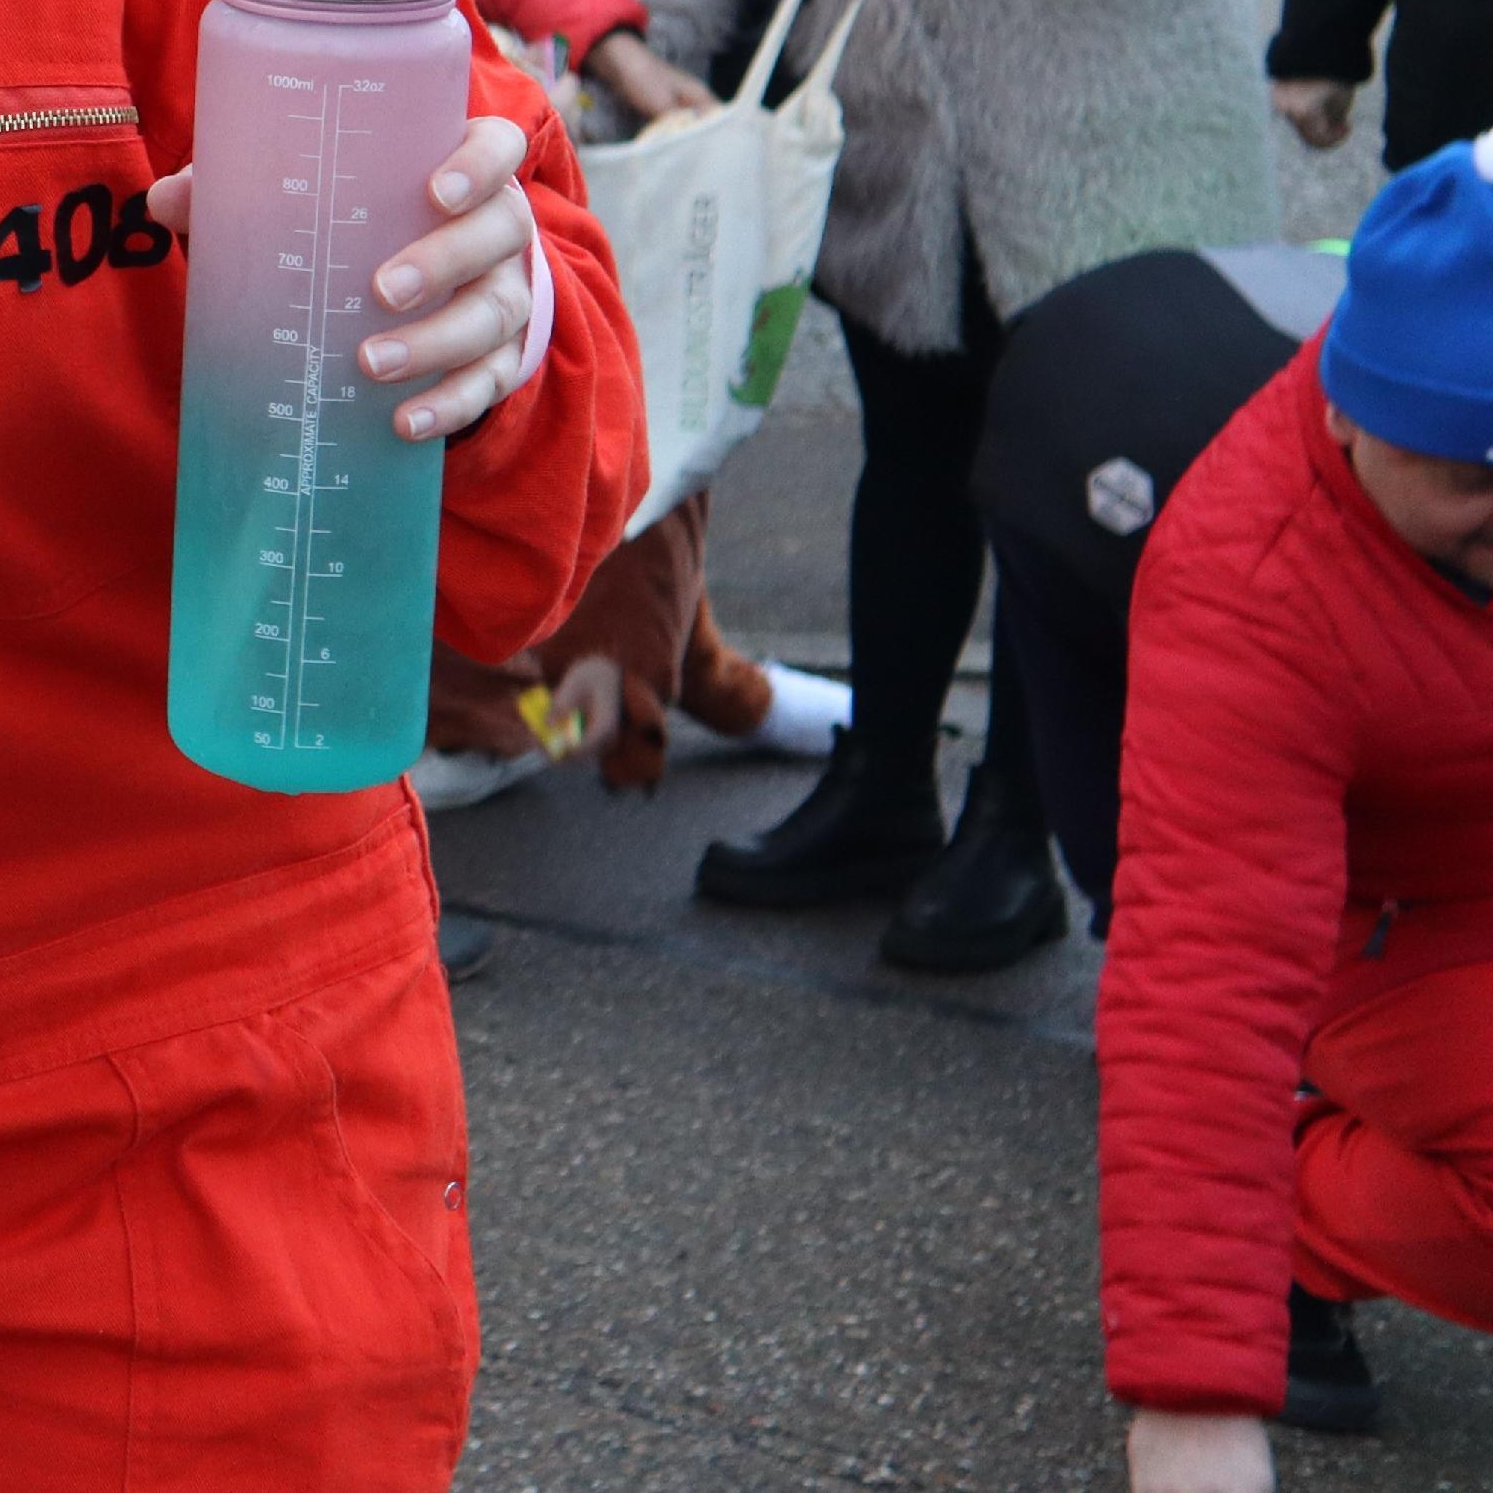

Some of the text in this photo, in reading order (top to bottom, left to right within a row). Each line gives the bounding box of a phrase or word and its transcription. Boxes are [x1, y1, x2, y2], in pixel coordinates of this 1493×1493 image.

[267, 73, 315, 92] 1000ml
[352, 78, 386, 93] 32oz
[281, 177, 309, 192] 800
[350, 208, 369, 221] 26
[277, 252, 304, 268] 700
[344, 296, 362, 309] 22
[272, 327, 299, 343] 600
[340, 385, 357, 399] 18
[268, 402, 294, 417] 500
[299, 344, 322, 497] APPROXIMATE CAPACITY
[263, 475, 290, 491] 400
[333, 473, 350, 486] 14
[258, 549, 285, 565] 300
[328, 561, 345, 574] 10
[254, 622, 280, 638] 200
[320, 647, 331, 660] 6
[250, 694, 276, 710] 100
[253, 731, 272, 746] 50
[314, 733, 326, 746] 2
